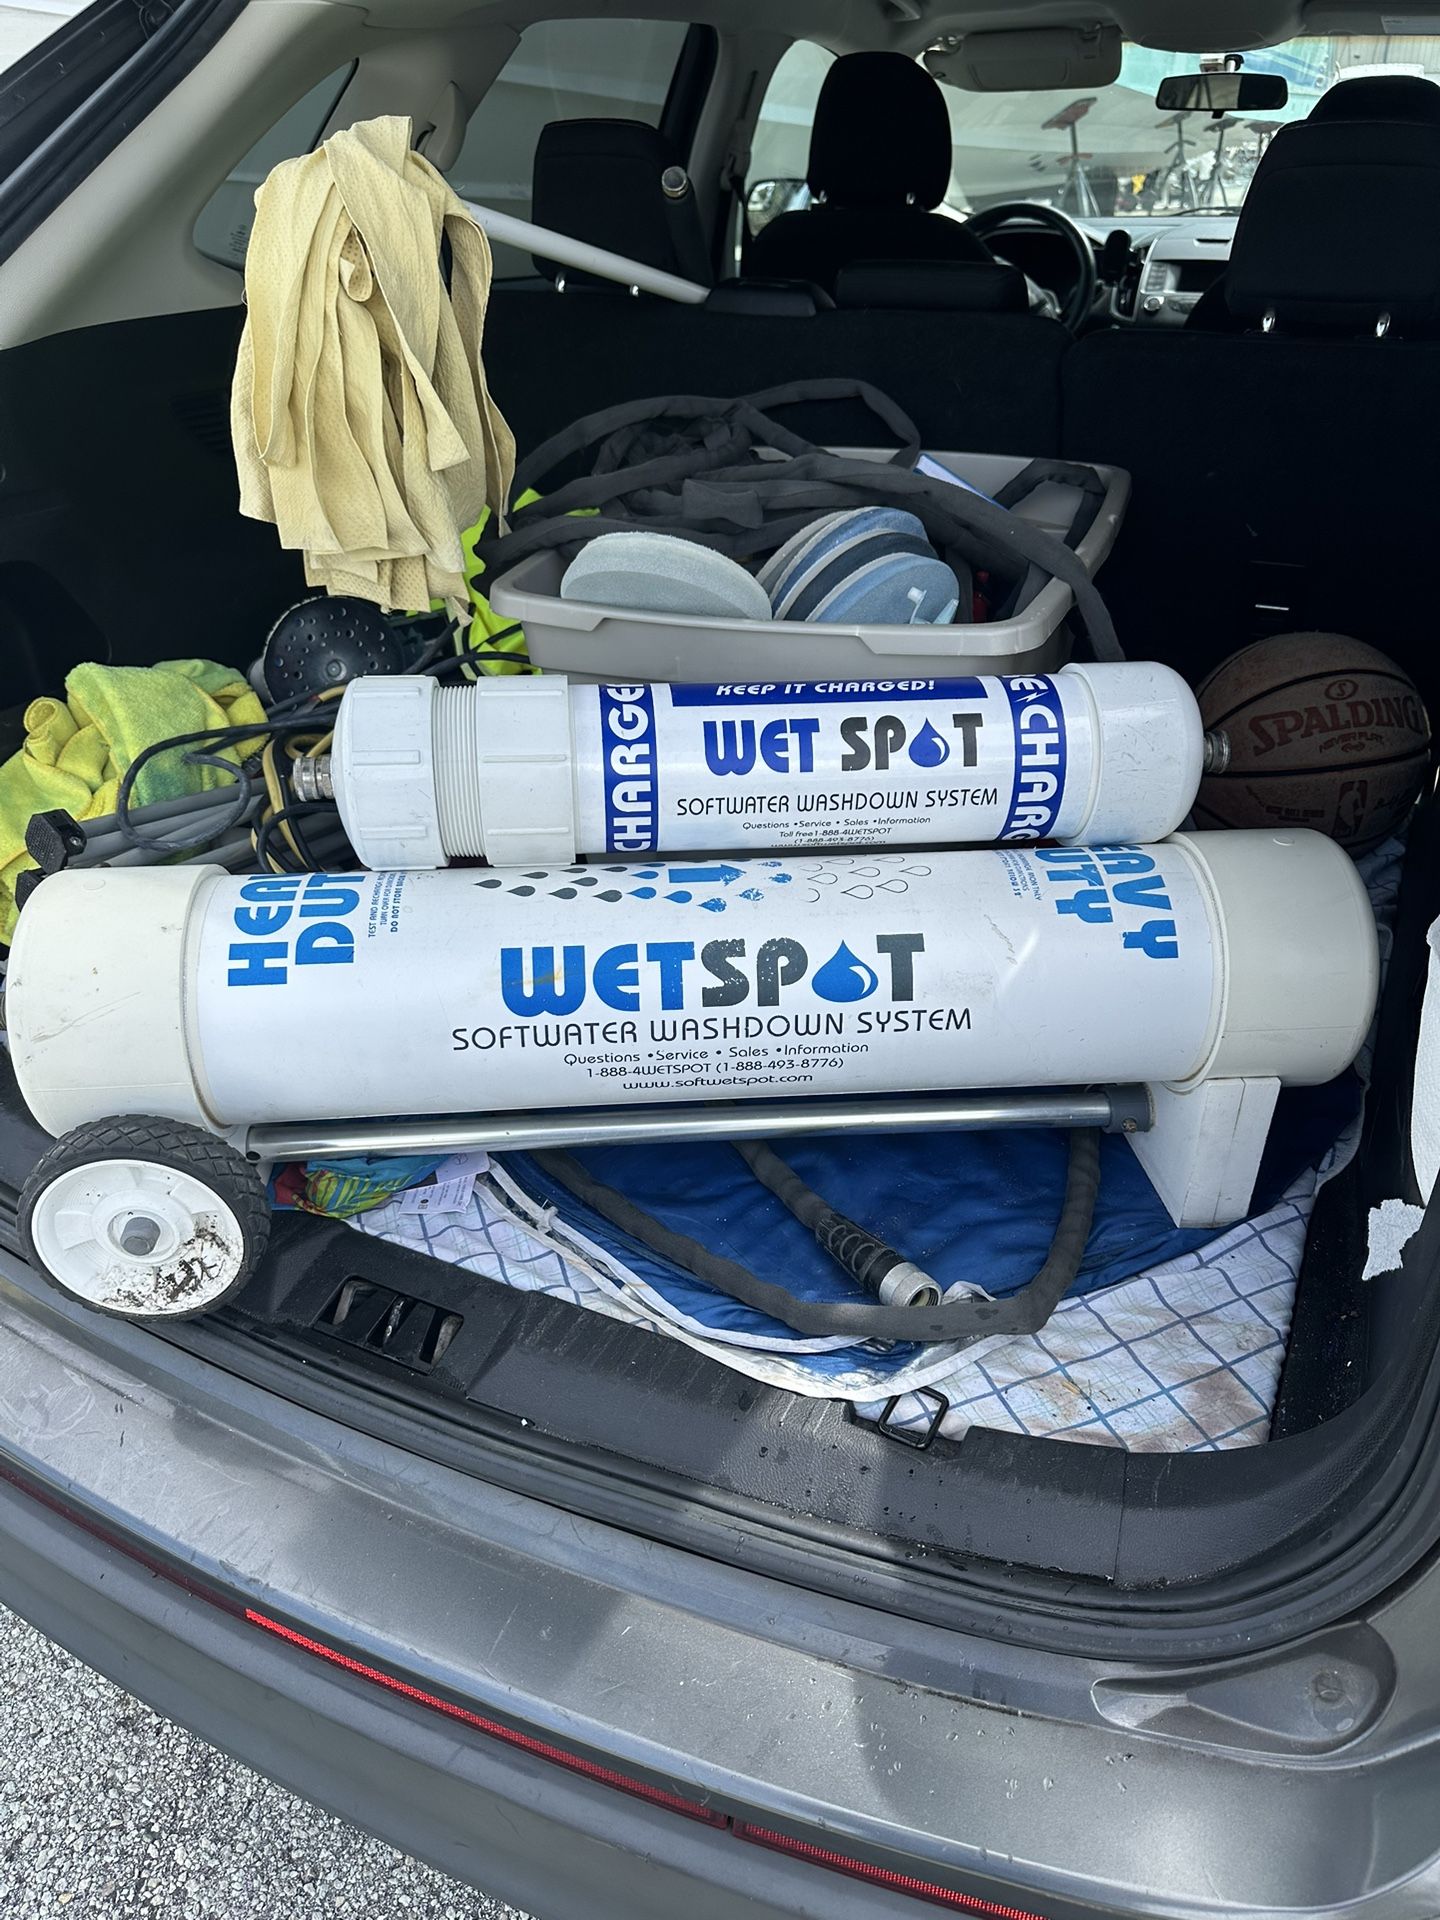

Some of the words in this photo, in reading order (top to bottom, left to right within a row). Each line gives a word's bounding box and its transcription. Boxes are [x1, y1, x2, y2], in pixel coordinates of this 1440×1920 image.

[716, 681, 777, 696] KEEP
[784, 680, 807, 694] IT
[815, 679, 936, 694] CHARGED!
[1249, 695, 1423, 756] SPALDING
[703, 718, 820, 777] WET
[606, 684, 654, 851] CHARGE
[677, 797, 790, 816] SOFTWATER
[796, 792, 919, 812] WASHDOWN
[926, 788, 998, 808] SYSTEM
[743, 821, 790, 830] Questions
[844, 818, 869, 826] Sales
[779, 830, 794, 838] Toll
[391, 905, 401, 919] NOT
[228, 872, 302, 987] HEA
[390, 920, 399, 933] DO
[452, 1022, 638, 1051] SOFTWATER
[650, 1014, 844, 1042] WASHDOWN
[856, 1008, 972, 1035] SYSTEM
[563, 1052, 641, 1067] Questions
[655, 1047, 709, 1062] Service
[729, 1044, 769, 1058] Sales
[784, 1041, 869, 1056] Information
[587, 1062, 712, 1078] 1-888-4WETSPOT
[715, 1057, 844, 1075] (1-888-493-8776)
[622, 1073, 813, 1090] www.softwetspot.com
